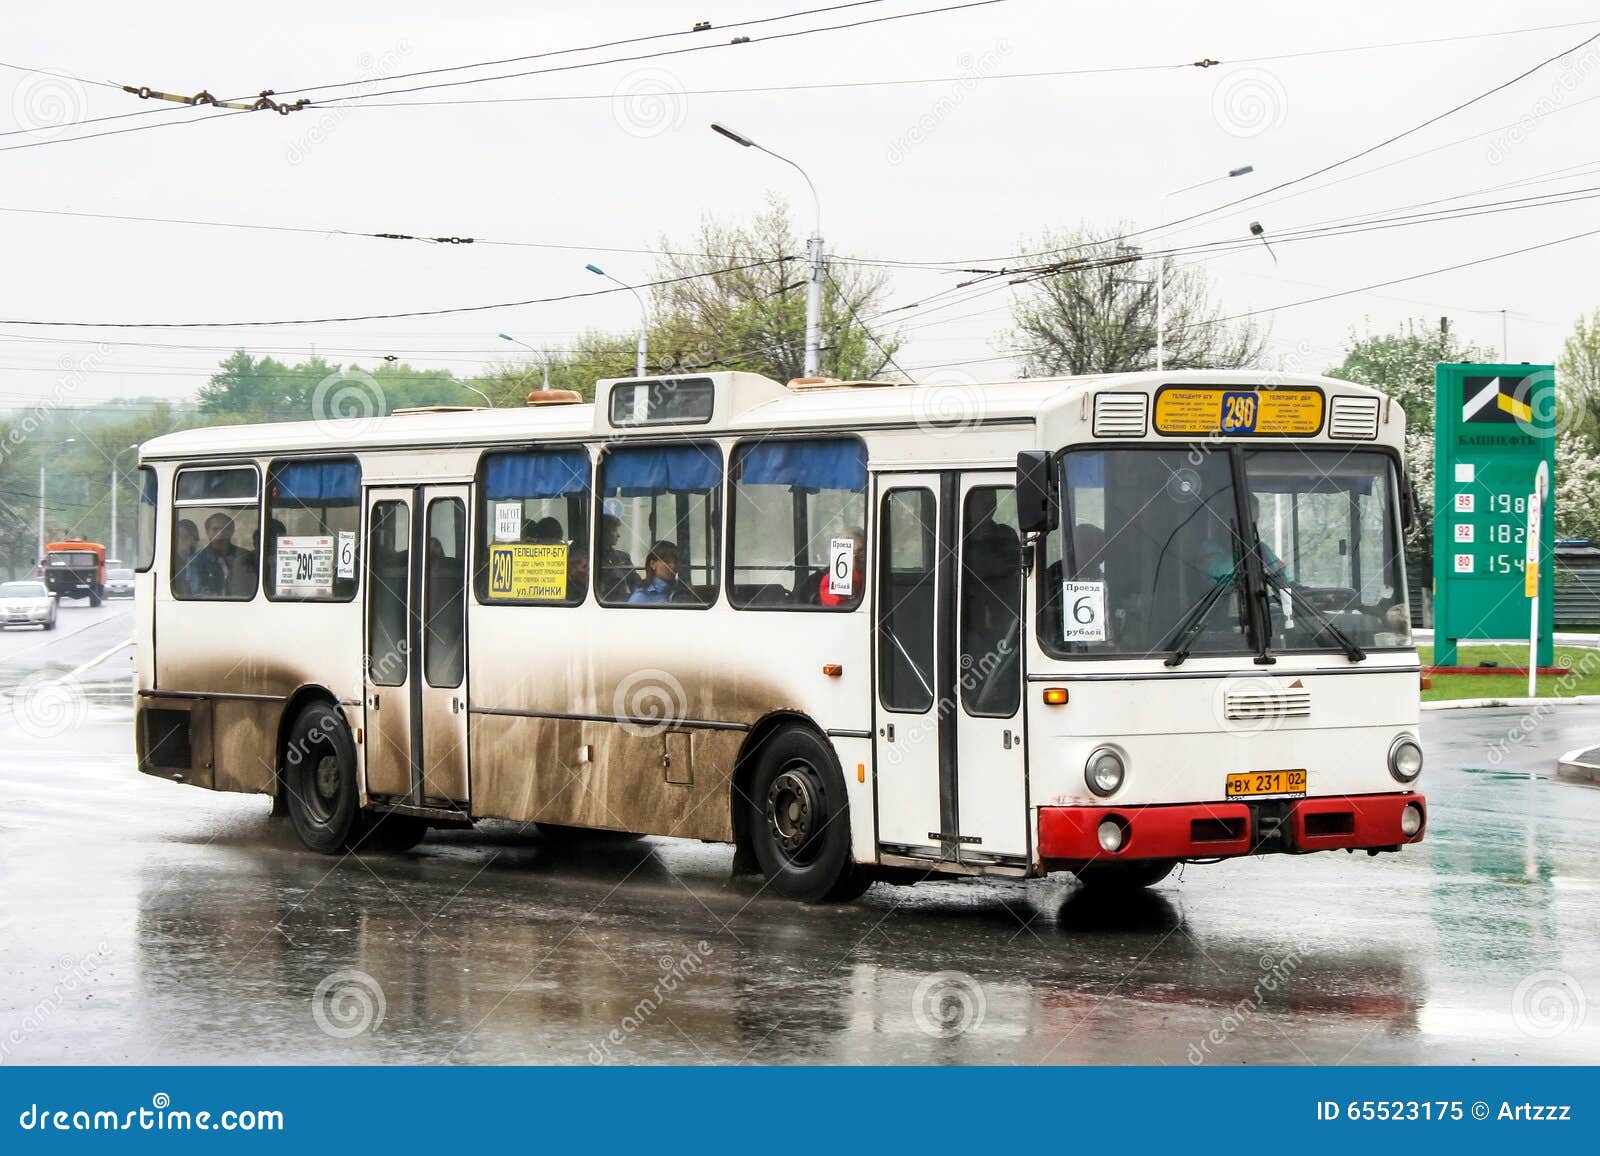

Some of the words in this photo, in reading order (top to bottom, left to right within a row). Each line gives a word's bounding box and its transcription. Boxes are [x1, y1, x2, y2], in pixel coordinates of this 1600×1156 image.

[1226, 396, 1254, 428] 290
[1458, 496, 1471, 506] 95
[501, 522, 516, 533] НЕТ
[1458, 526, 1470, 536] 92
[341, 542, 351, 565] 6
[1458, 556, 1471, 566] 80
[296, 553, 313, 580] 290
[493, 553, 511, 590] 290
[836, 552, 848, 579] 6
[1066, 584, 1100, 592] Проезд
[1073, 596, 1095, 624] 6
[1066, 628, 1101, 636] рублей
[1256, 774, 1280, 791] 231
[1288, 773, 1301, 785] 02
